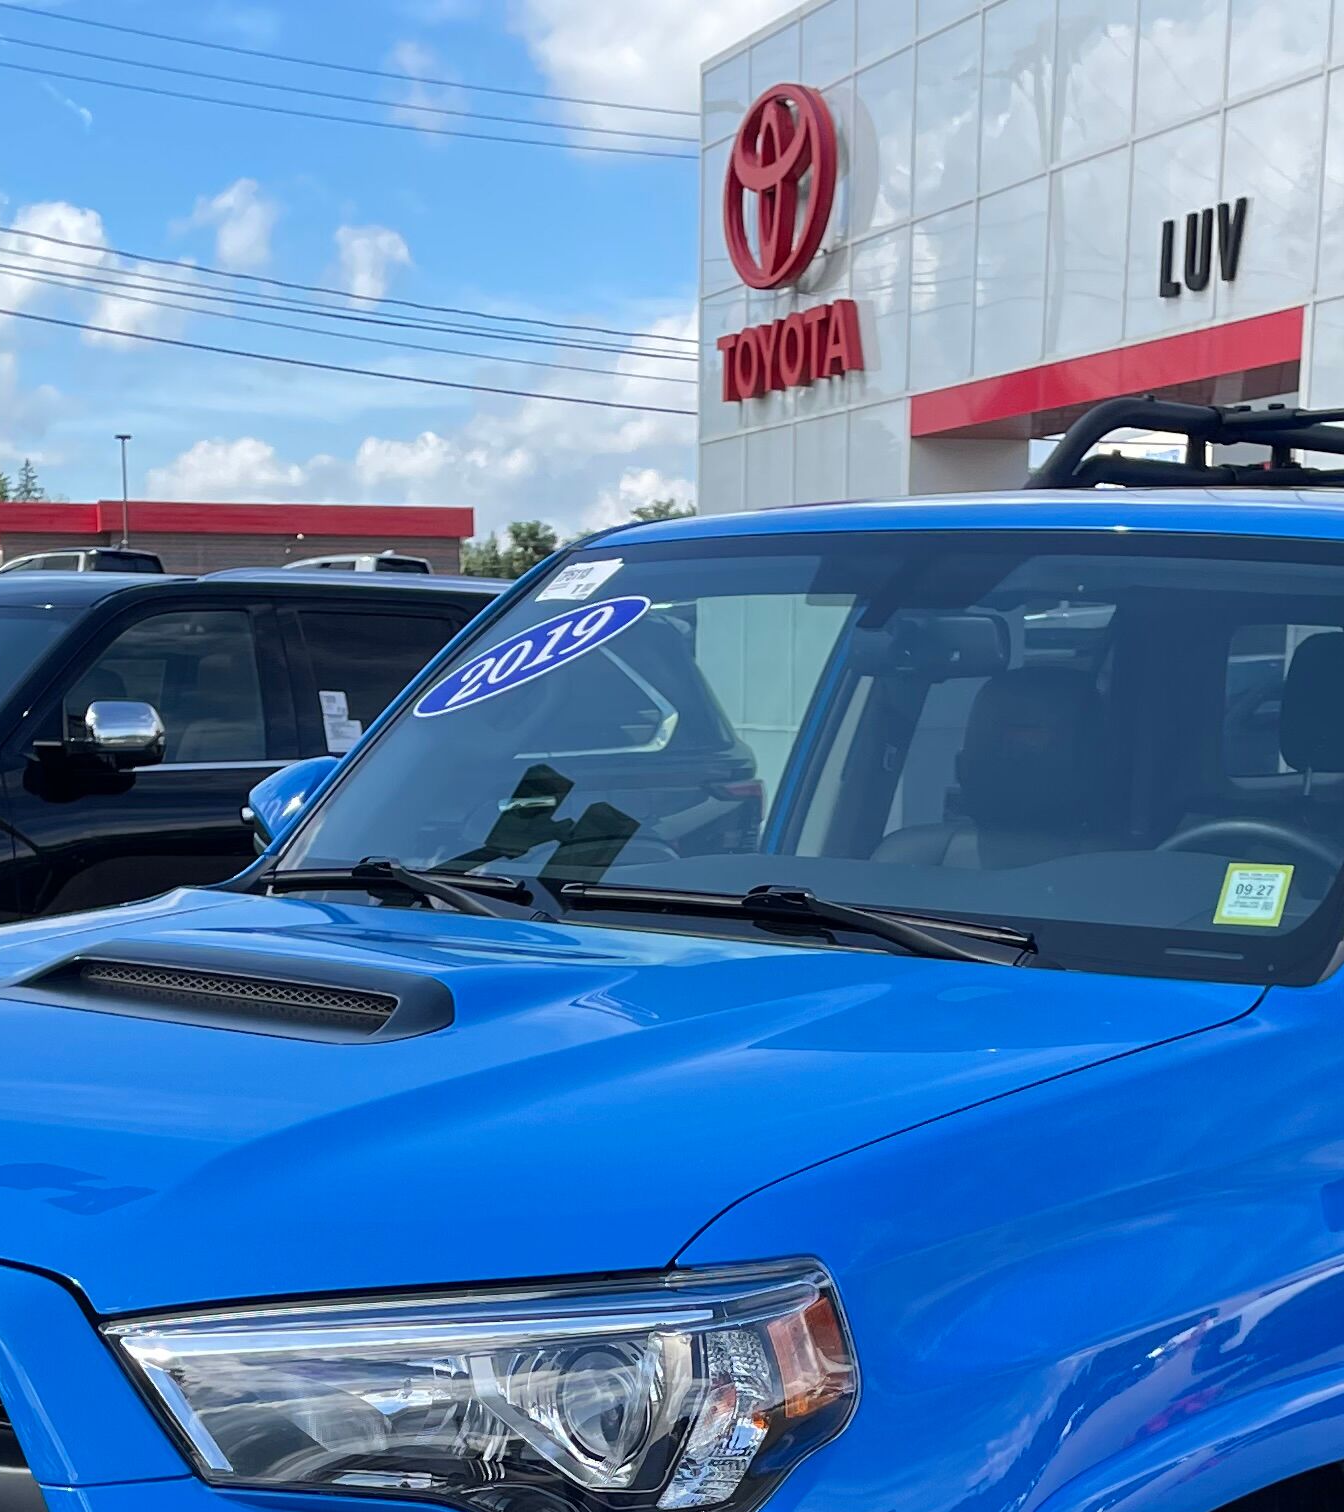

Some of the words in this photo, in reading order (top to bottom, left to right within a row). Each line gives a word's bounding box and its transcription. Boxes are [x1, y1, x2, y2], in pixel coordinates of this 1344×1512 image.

[1159, 197, 1247, 298] LUV
[716, 298, 864, 402] TOYOTA
[445, 605, 615, 707] 2019
[1236, 884, 1253, 896] 09
[1257, 885, 1275, 896] 27
